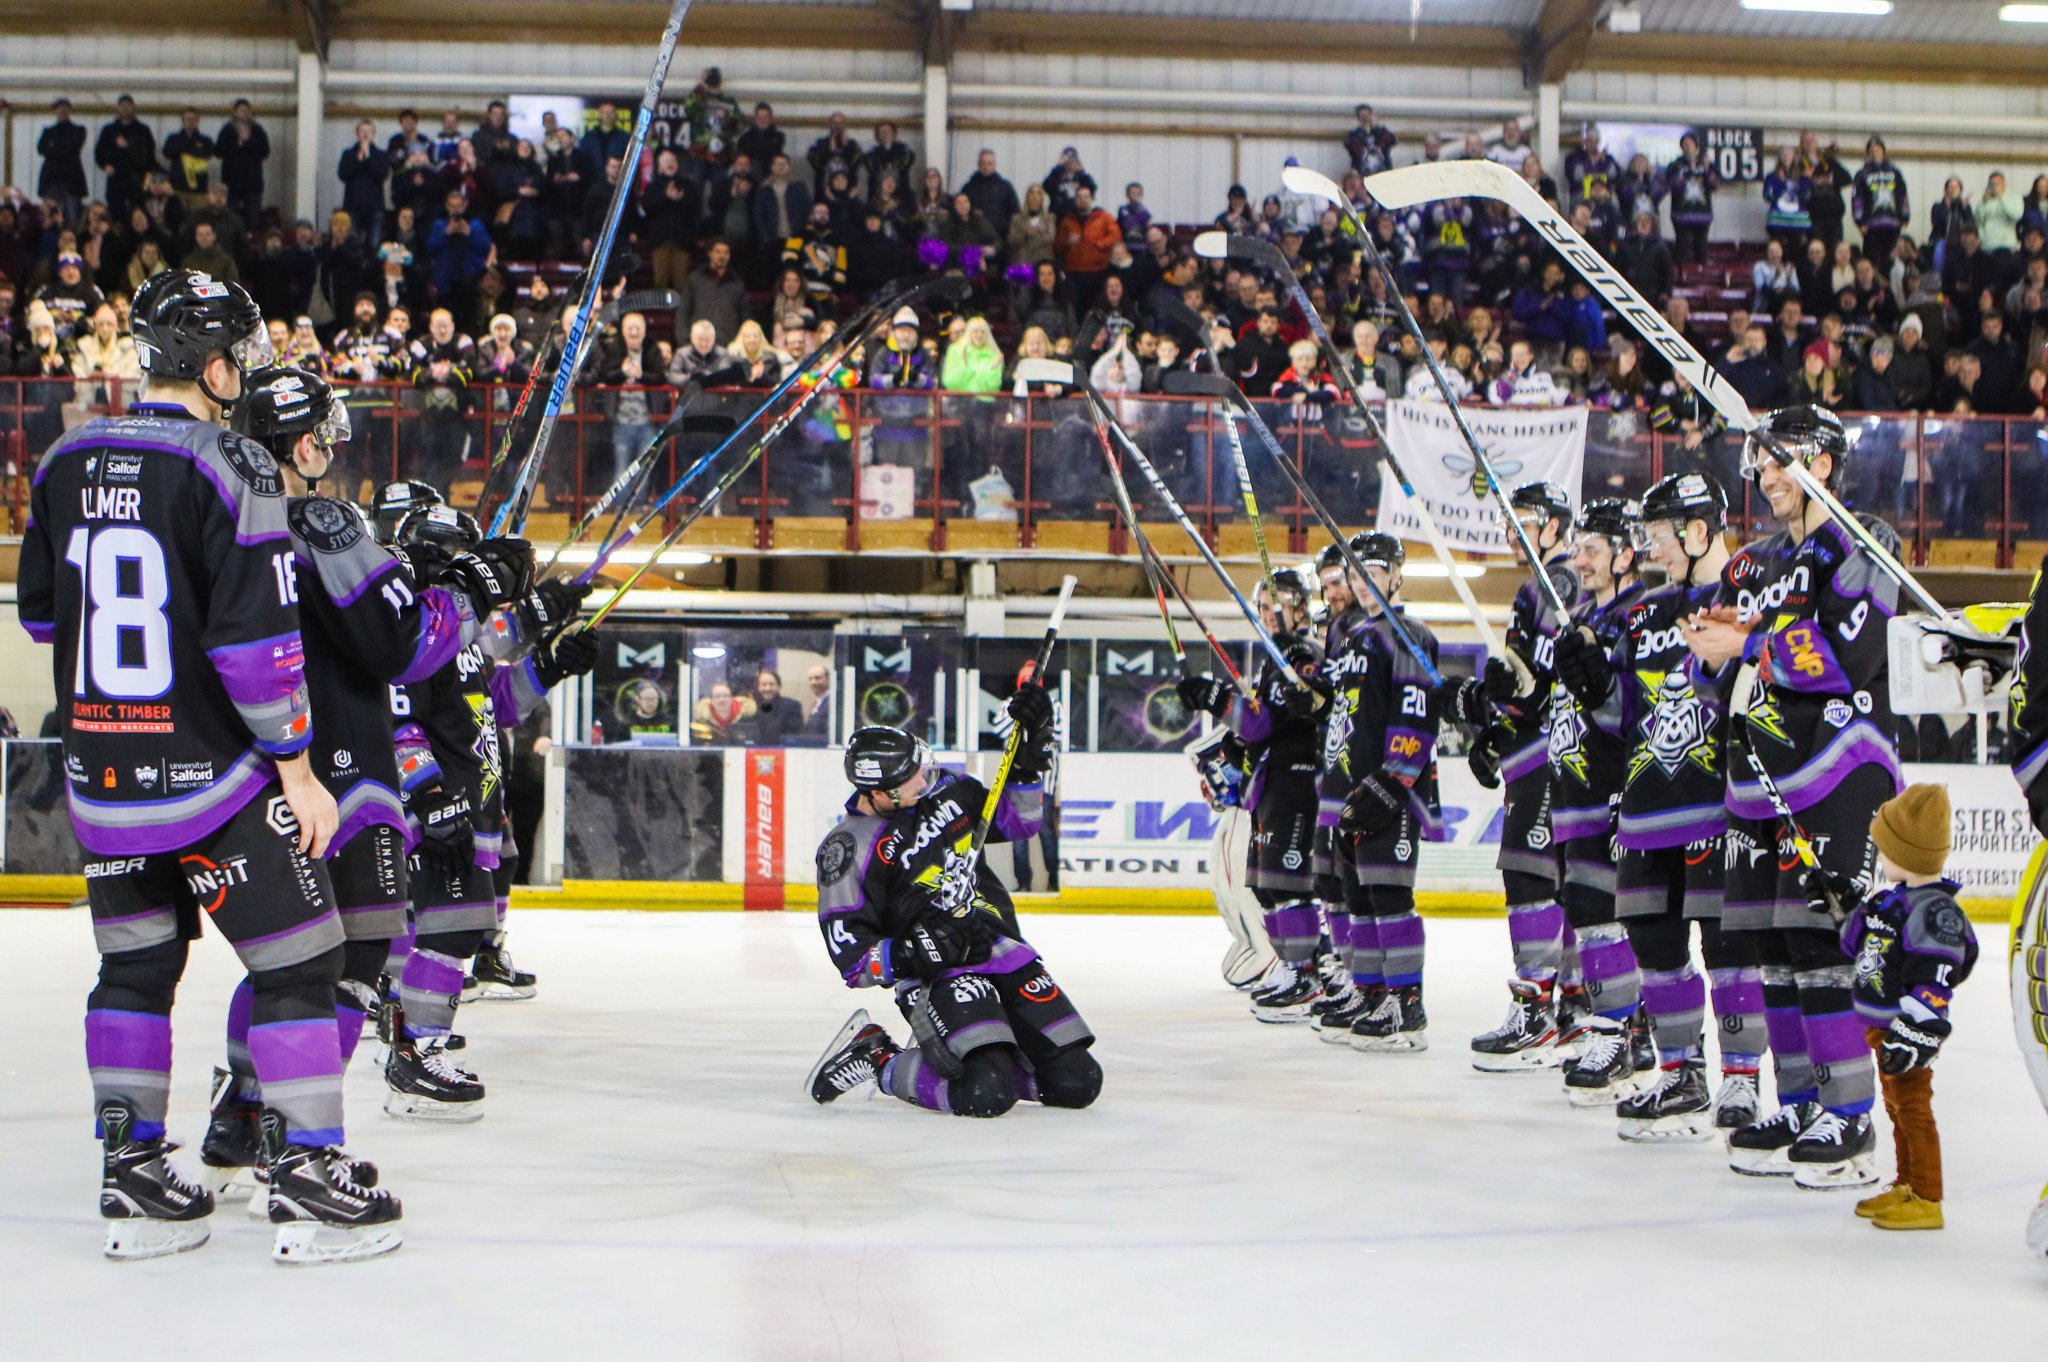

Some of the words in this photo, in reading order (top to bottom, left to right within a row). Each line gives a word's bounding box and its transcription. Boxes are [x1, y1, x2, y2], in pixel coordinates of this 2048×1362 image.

[652, 103, 687, 117] OCK
[654, 121, 691, 149] 04
[1707, 128, 1752, 147] BLOCK
[1537, 218, 1695, 364] BAUER
[550, 324, 585, 409] BAUER
[1457, 419, 1578, 438] ANCHESTER
[107, 462, 141, 475] Salford
[65, 524, 175, 701] 18
[1838, 600, 1869, 642] 9
[1534, 634, 1555, 671] 10
[1785, 628, 1826, 678] CNP
[117, 704, 171, 720] TIMBER
[1401, 684, 1427, 718] 20
[120, 723, 172, 732] MERCHANTS
[1390, 734, 1422, 758] CNP
[169, 762, 203, 771] University
[170, 768, 213, 782] Salford
[170, 781, 214, 790] MANCHESTER
[757, 783, 772, 879] BAUER
[84, 856, 147, 879] BAUER
[290, 835, 323, 908] DNAMIS
[379, 827, 396, 896] DUNAMIS
[1058, 857, 1179, 874] ATION
[1893, 1020, 1942, 1048] Reebok
[166, 1189, 192, 1207] CCM
[331, 1190, 369, 1208] CCM
